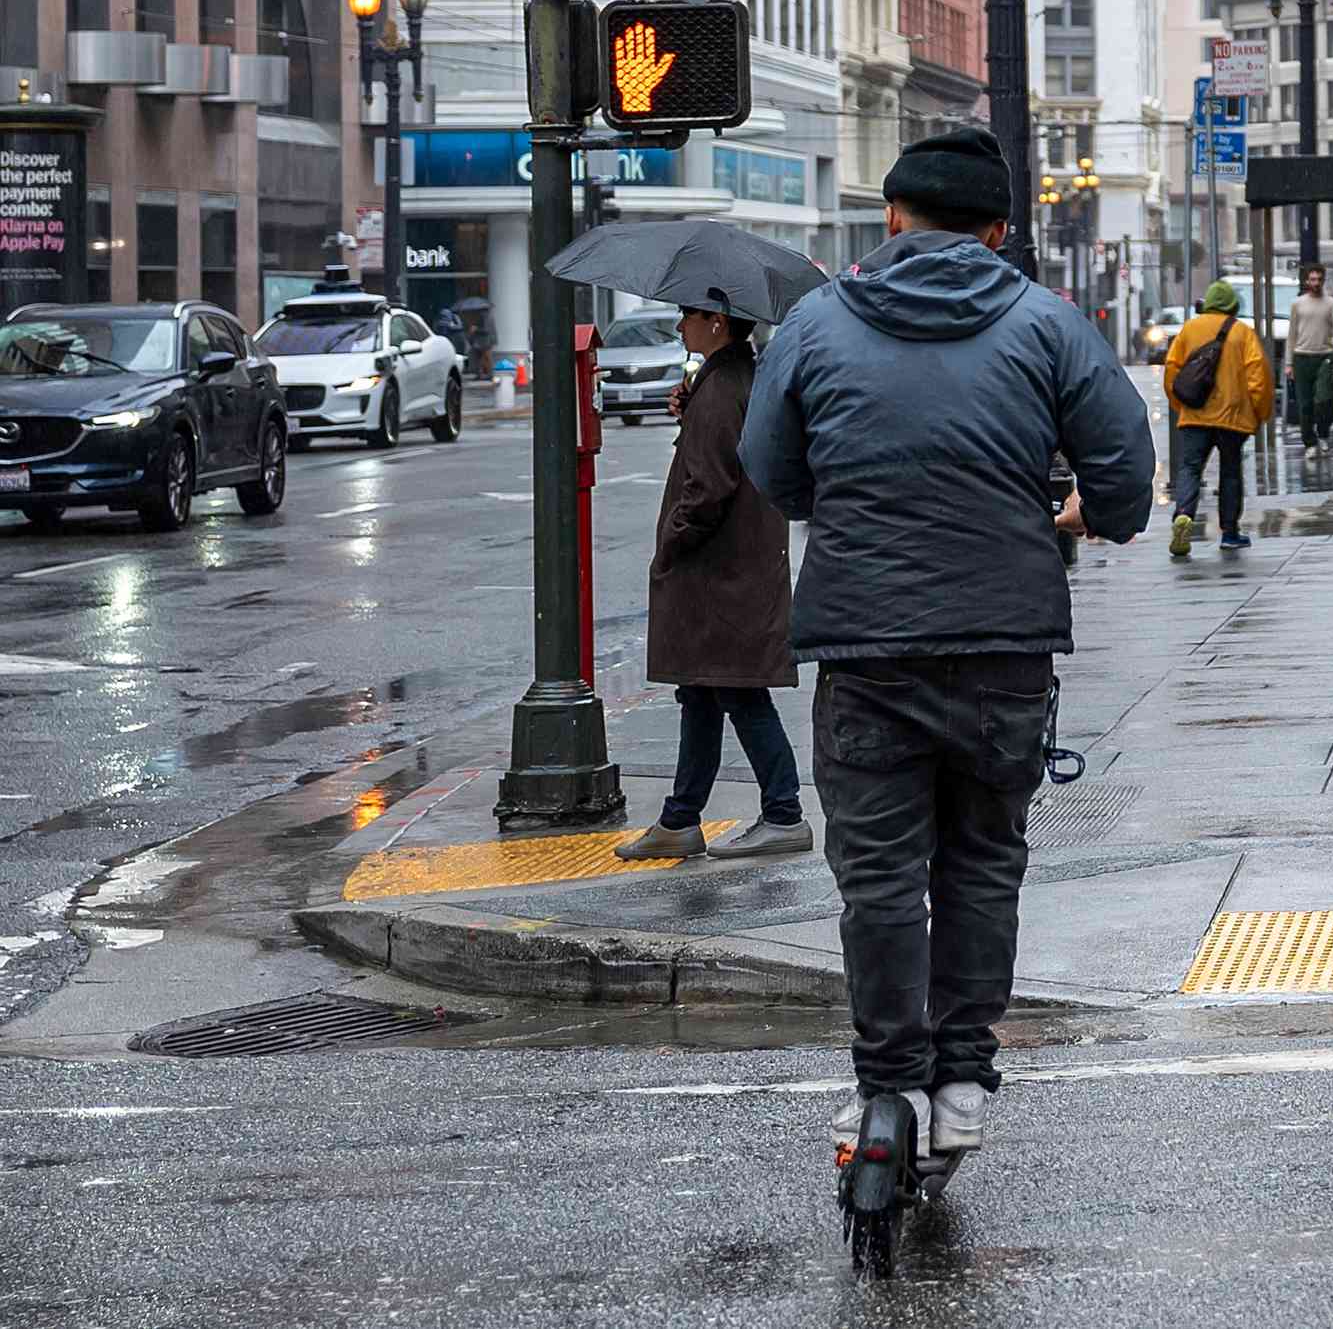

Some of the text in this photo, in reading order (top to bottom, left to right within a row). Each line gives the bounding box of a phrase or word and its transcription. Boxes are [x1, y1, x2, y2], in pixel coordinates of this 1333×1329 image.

[1215, 42, 1231, 58] NO
[0, 151, 60, 167] Discover
[0, 168, 72, 186] the perfect
[0, 185, 61, 203] payment
[0, 201, 53, 217] combo:
[0, 218, 64, 233] Klarna on
[0, 234, 65, 253] Apple Pay
[405, 245, 450, 268] bank
